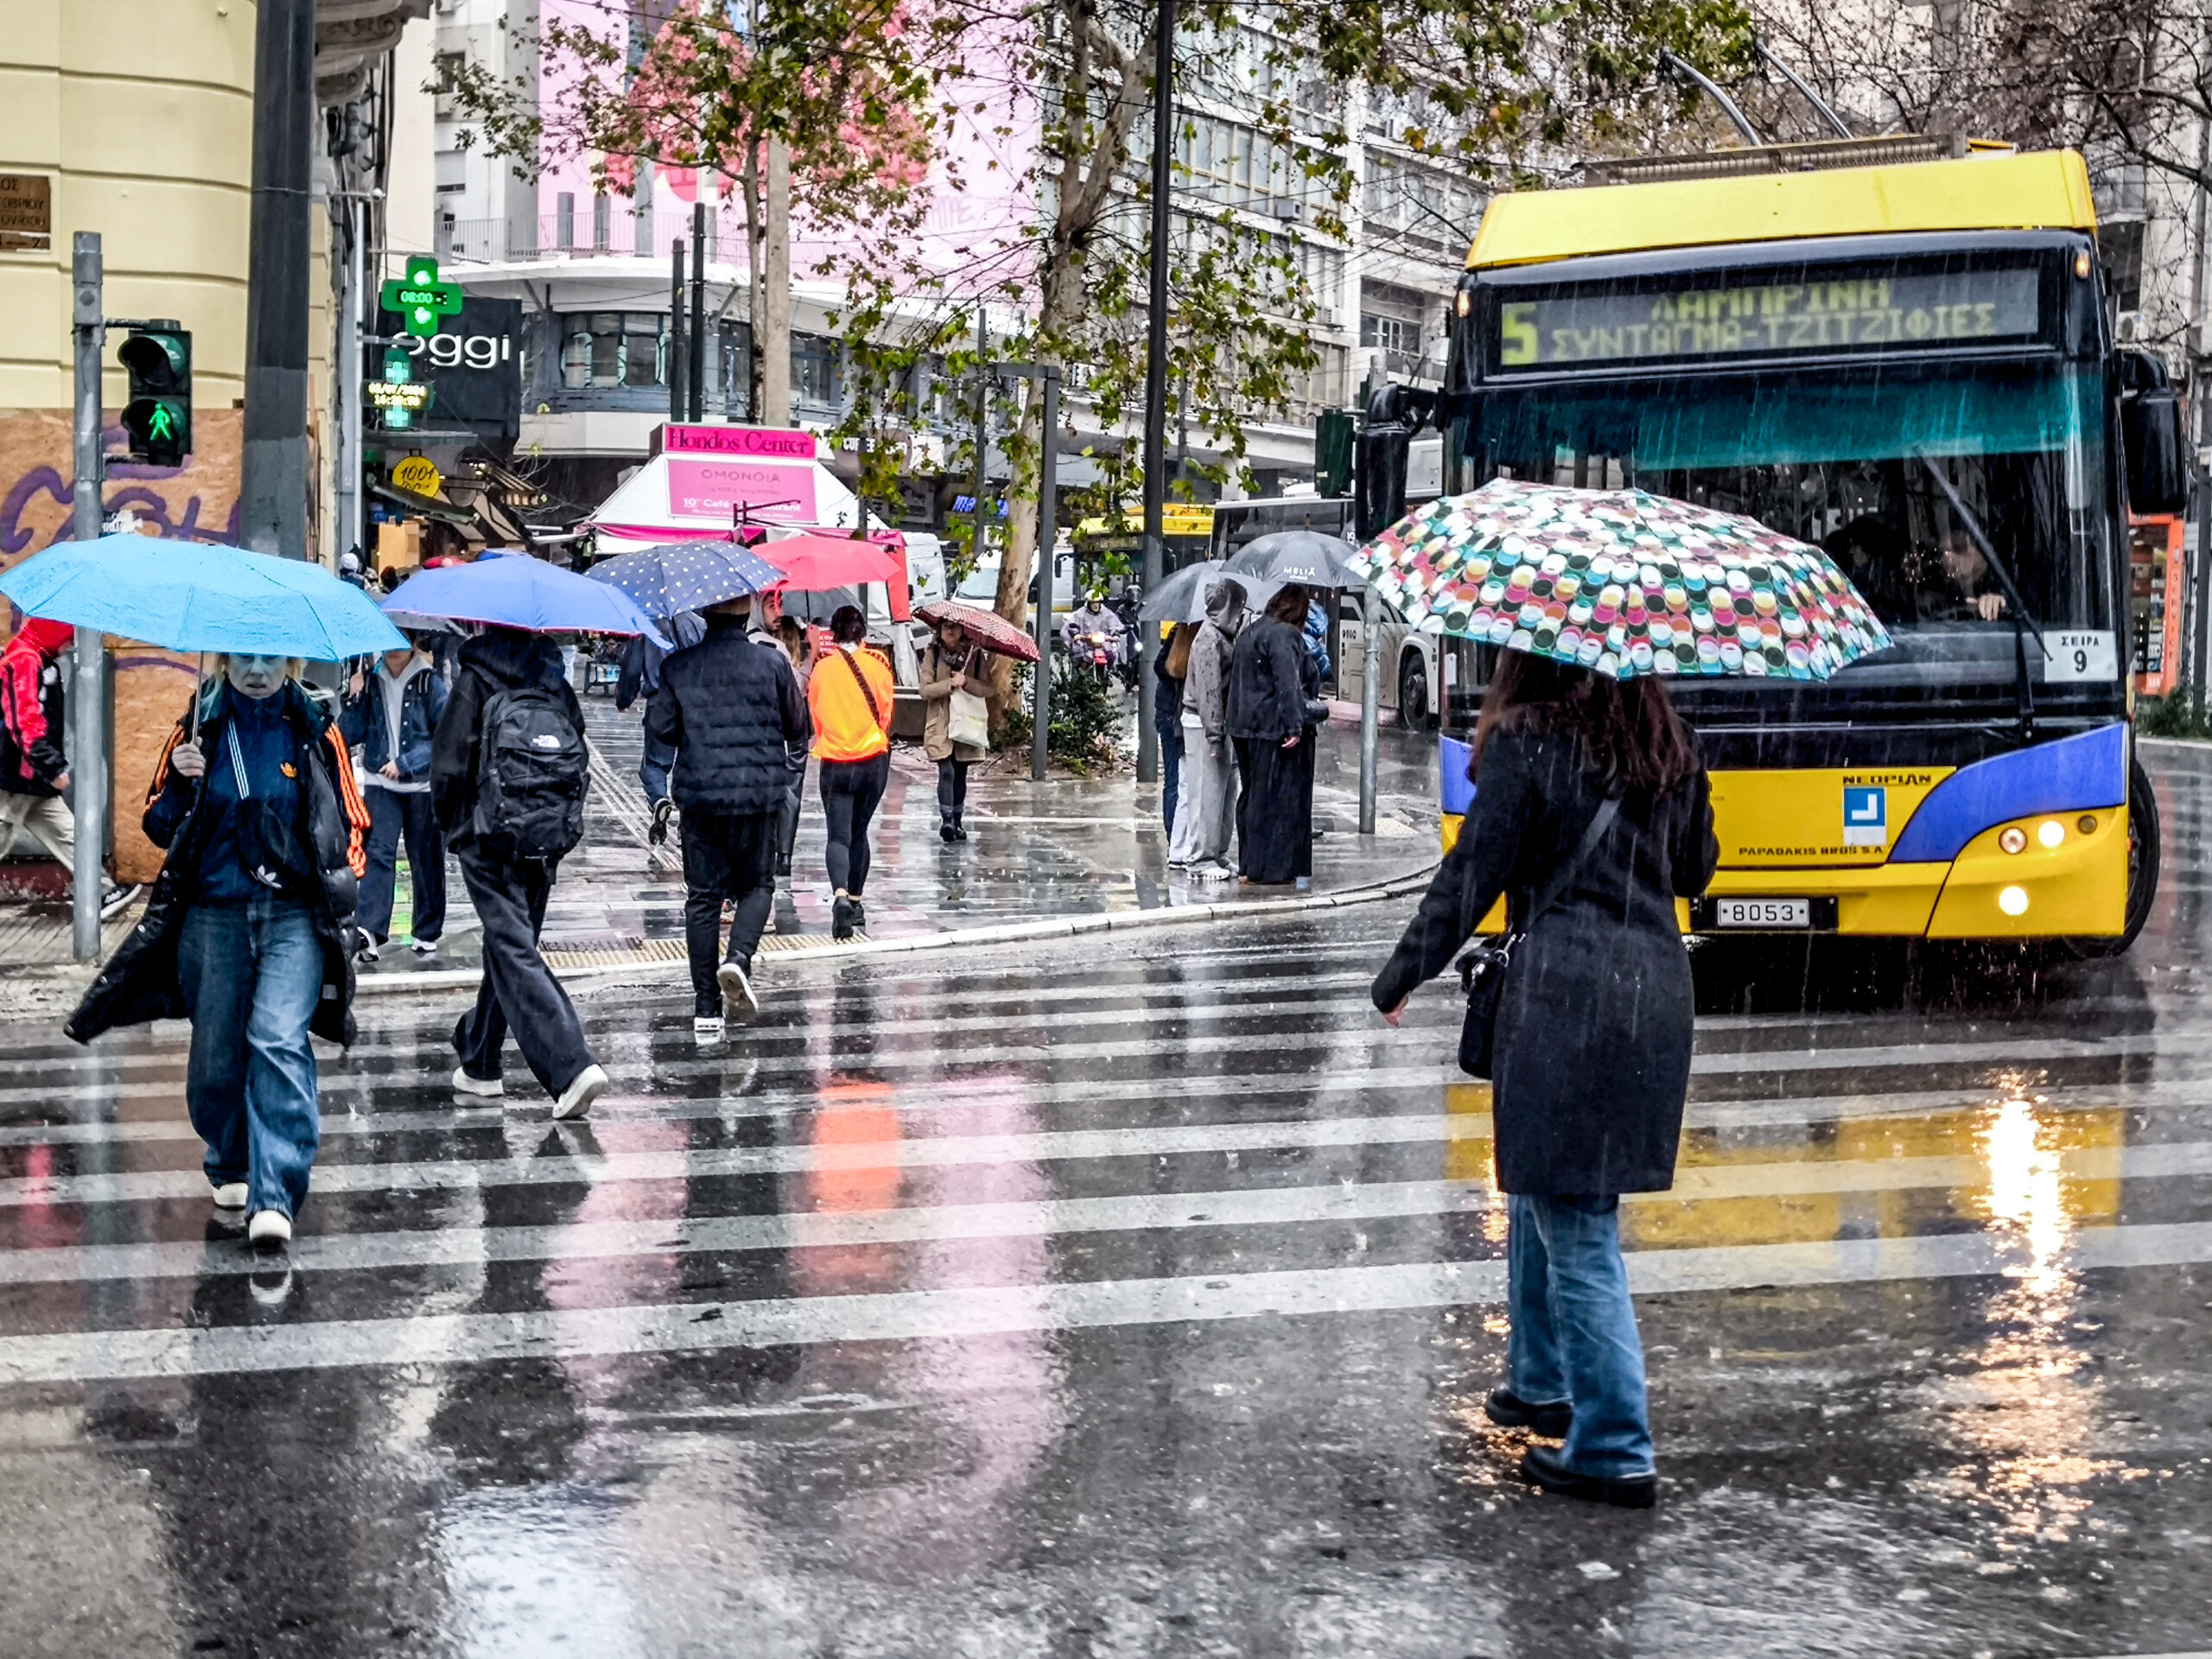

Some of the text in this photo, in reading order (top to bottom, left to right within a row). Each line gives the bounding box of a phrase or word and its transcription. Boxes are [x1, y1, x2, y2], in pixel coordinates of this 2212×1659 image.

[0, 177, 19, 192] ΟΣ
[1501, 302, 1538, 365] 5
[391, 331, 510, 369] oggi
[668, 427, 809, 454] Hondos Center
[401, 465, 435, 481] 1001
[702, 498, 730, 509] Café
[2074, 649, 2088, 672] 9
[1738, 846, 1817, 856] PAPADAKIS
[1732, 904, 1795, 922] 8053
